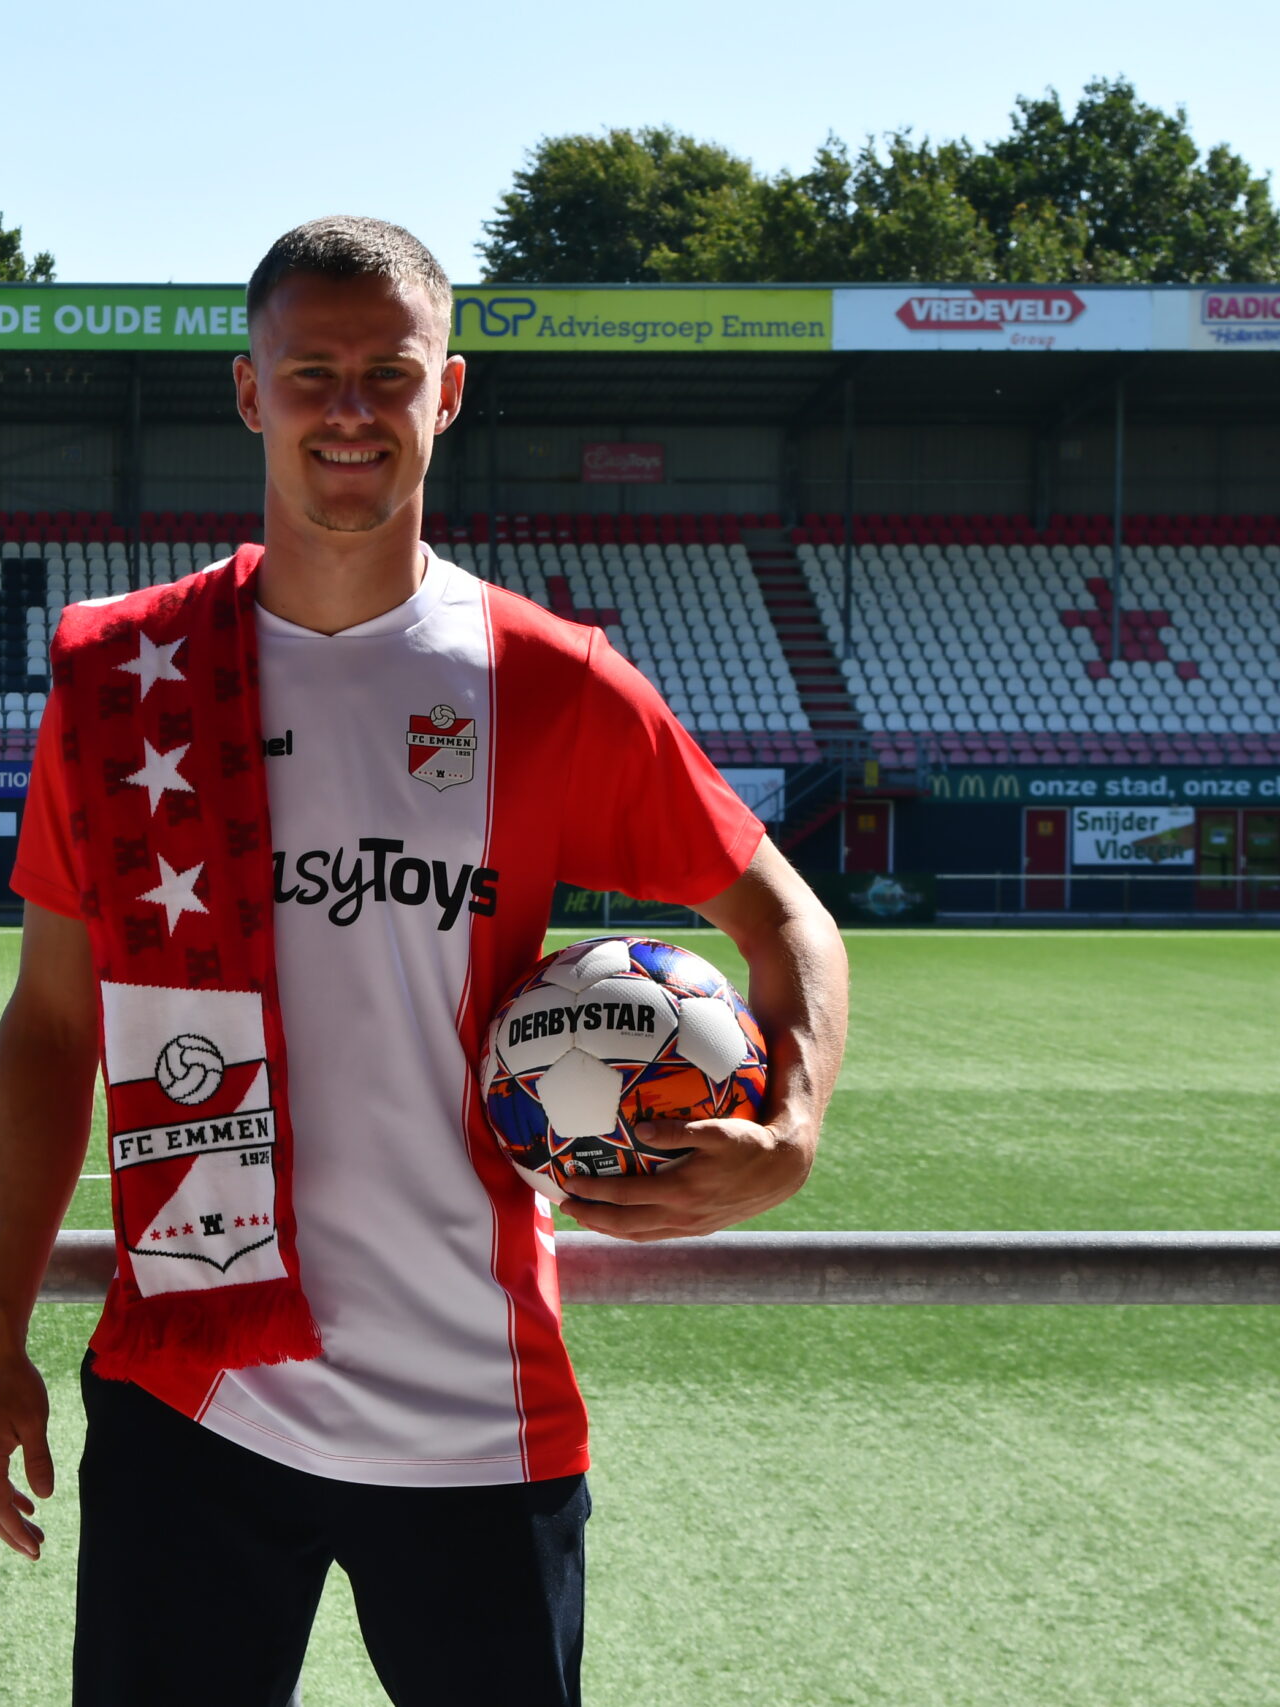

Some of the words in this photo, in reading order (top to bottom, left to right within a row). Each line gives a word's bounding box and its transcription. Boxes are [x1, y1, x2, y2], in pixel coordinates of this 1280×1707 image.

[54, 305, 162, 335] OUDE
[173, 306, 248, 335] MEE
[909, 298, 1073, 323] VREDEVELD
[536, 314, 713, 344] Adviesgroep
[721, 315, 825, 338] Emmen
[412, 735, 425, 743] FC
[429, 736, 471, 747] EMMEN
[1029, 780, 1097, 796] onze
[1105, 775, 1175, 799] stad,
[1183, 780, 1251, 796] onze
[1259, 775, 1280, 796] cl
[1077, 811, 1159, 836] Snijder
[564, 890, 605, 912] HET
[509, 1003, 655, 1047] DERBYSTAR
[118, 1134, 153, 1159] FC
[165, 1117, 269, 1151] EMMEN
[239, 1151, 270, 1167] 1925
